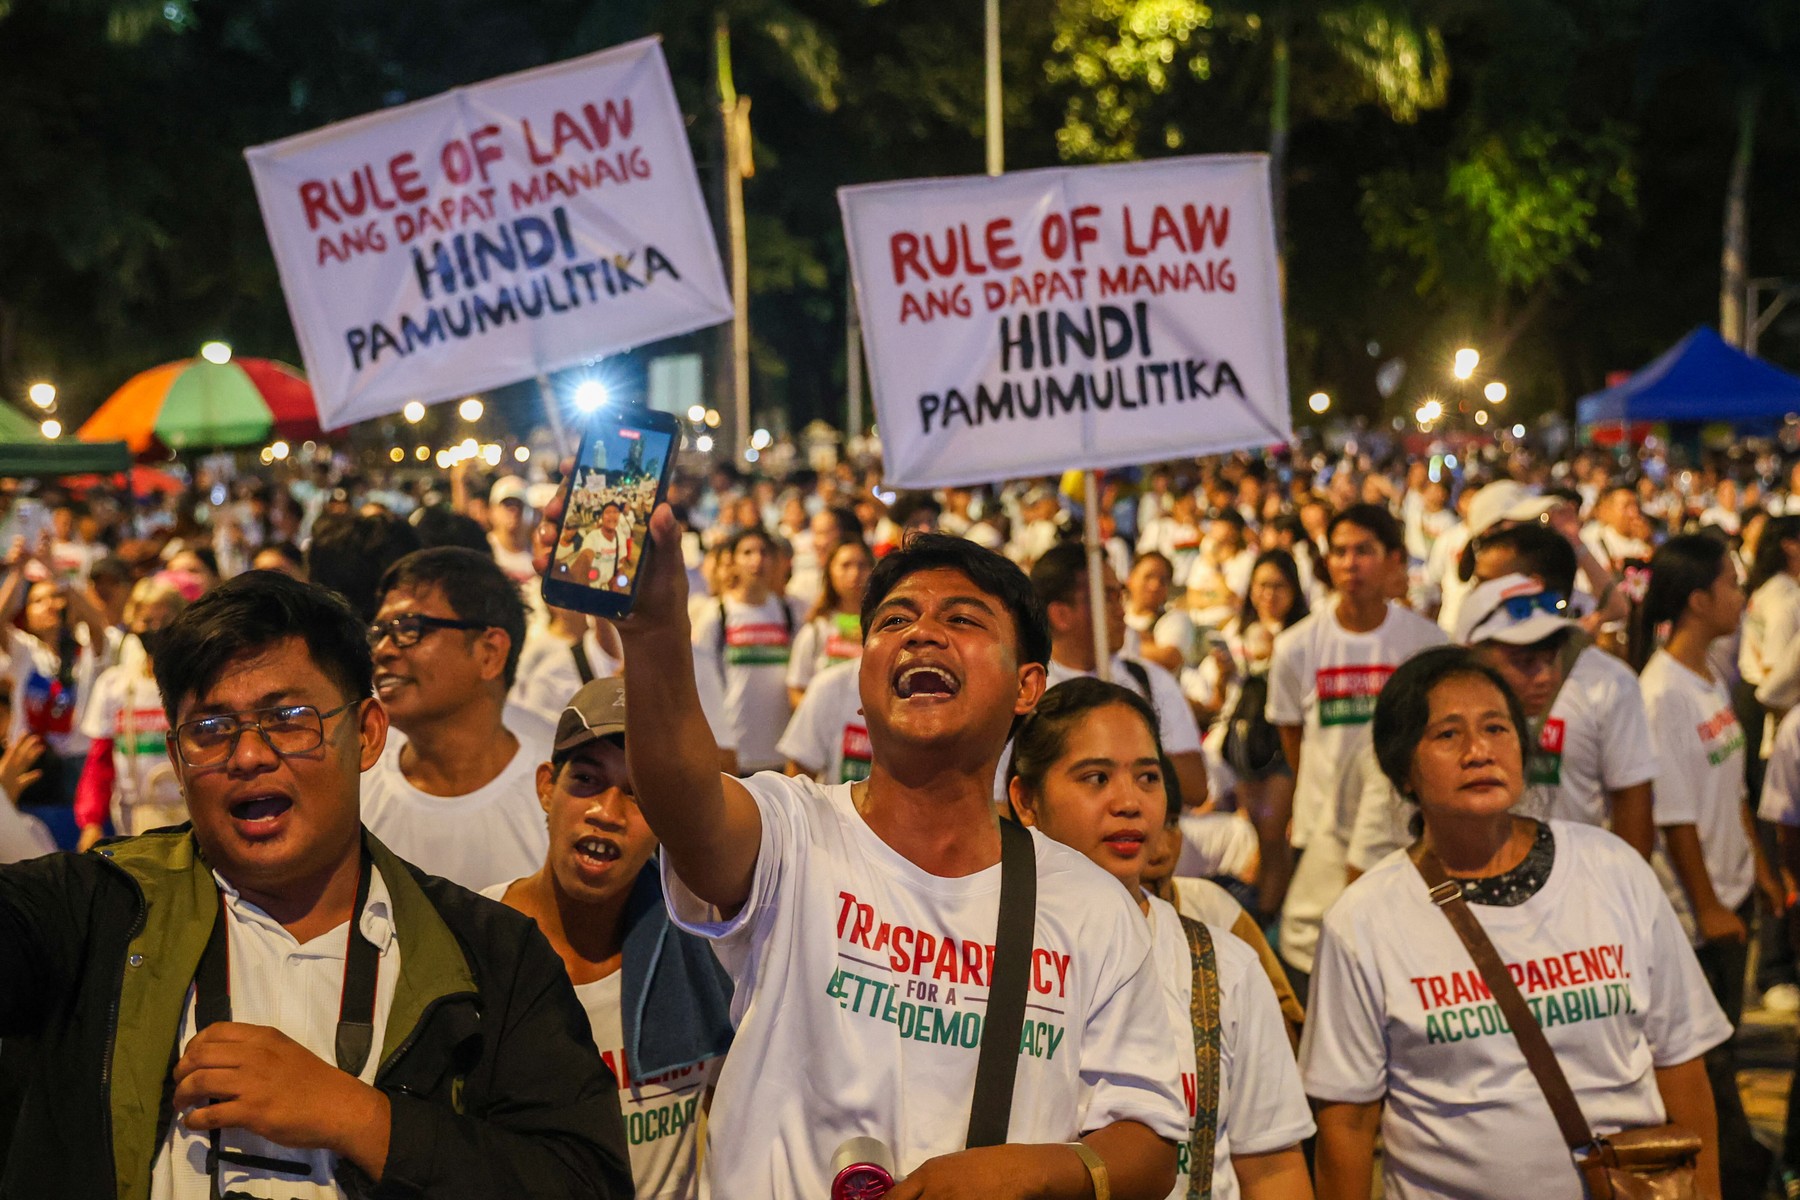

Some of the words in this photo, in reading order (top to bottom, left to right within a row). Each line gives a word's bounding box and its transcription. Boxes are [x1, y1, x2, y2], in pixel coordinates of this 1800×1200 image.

[297, 152, 429, 231] RULE
[440, 124, 504, 186] OF
[521, 99, 634, 167] LAW
[317, 222, 387, 267] ANG
[397, 188, 496, 245] DAPAT
[510, 146, 651, 211] MANAIG
[411, 206, 577, 300] HINDI
[889, 217, 1023, 286] RULE
[1040, 205, 1102, 263] OF
[1123, 203, 1230, 258] LAW
[346, 246, 681, 371] PAMUMULITIKA
[900, 283, 971, 325] ANG
[984, 267, 1087, 312] DAPAT
[1099, 258, 1236, 297] MANAIG
[999, 301, 1152, 372] HINDI
[918, 360, 1244, 434] PAMUMULITIKA
[906, 979, 938, 1003] FOR
[945, 987, 957, 1006] A
[1410, 944, 1631, 1011] TRANPARENCY.
[898, 1001, 1065, 1060] DEMOACY
[1427, 983, 1637, 1045] ACCOUTABILITY.
